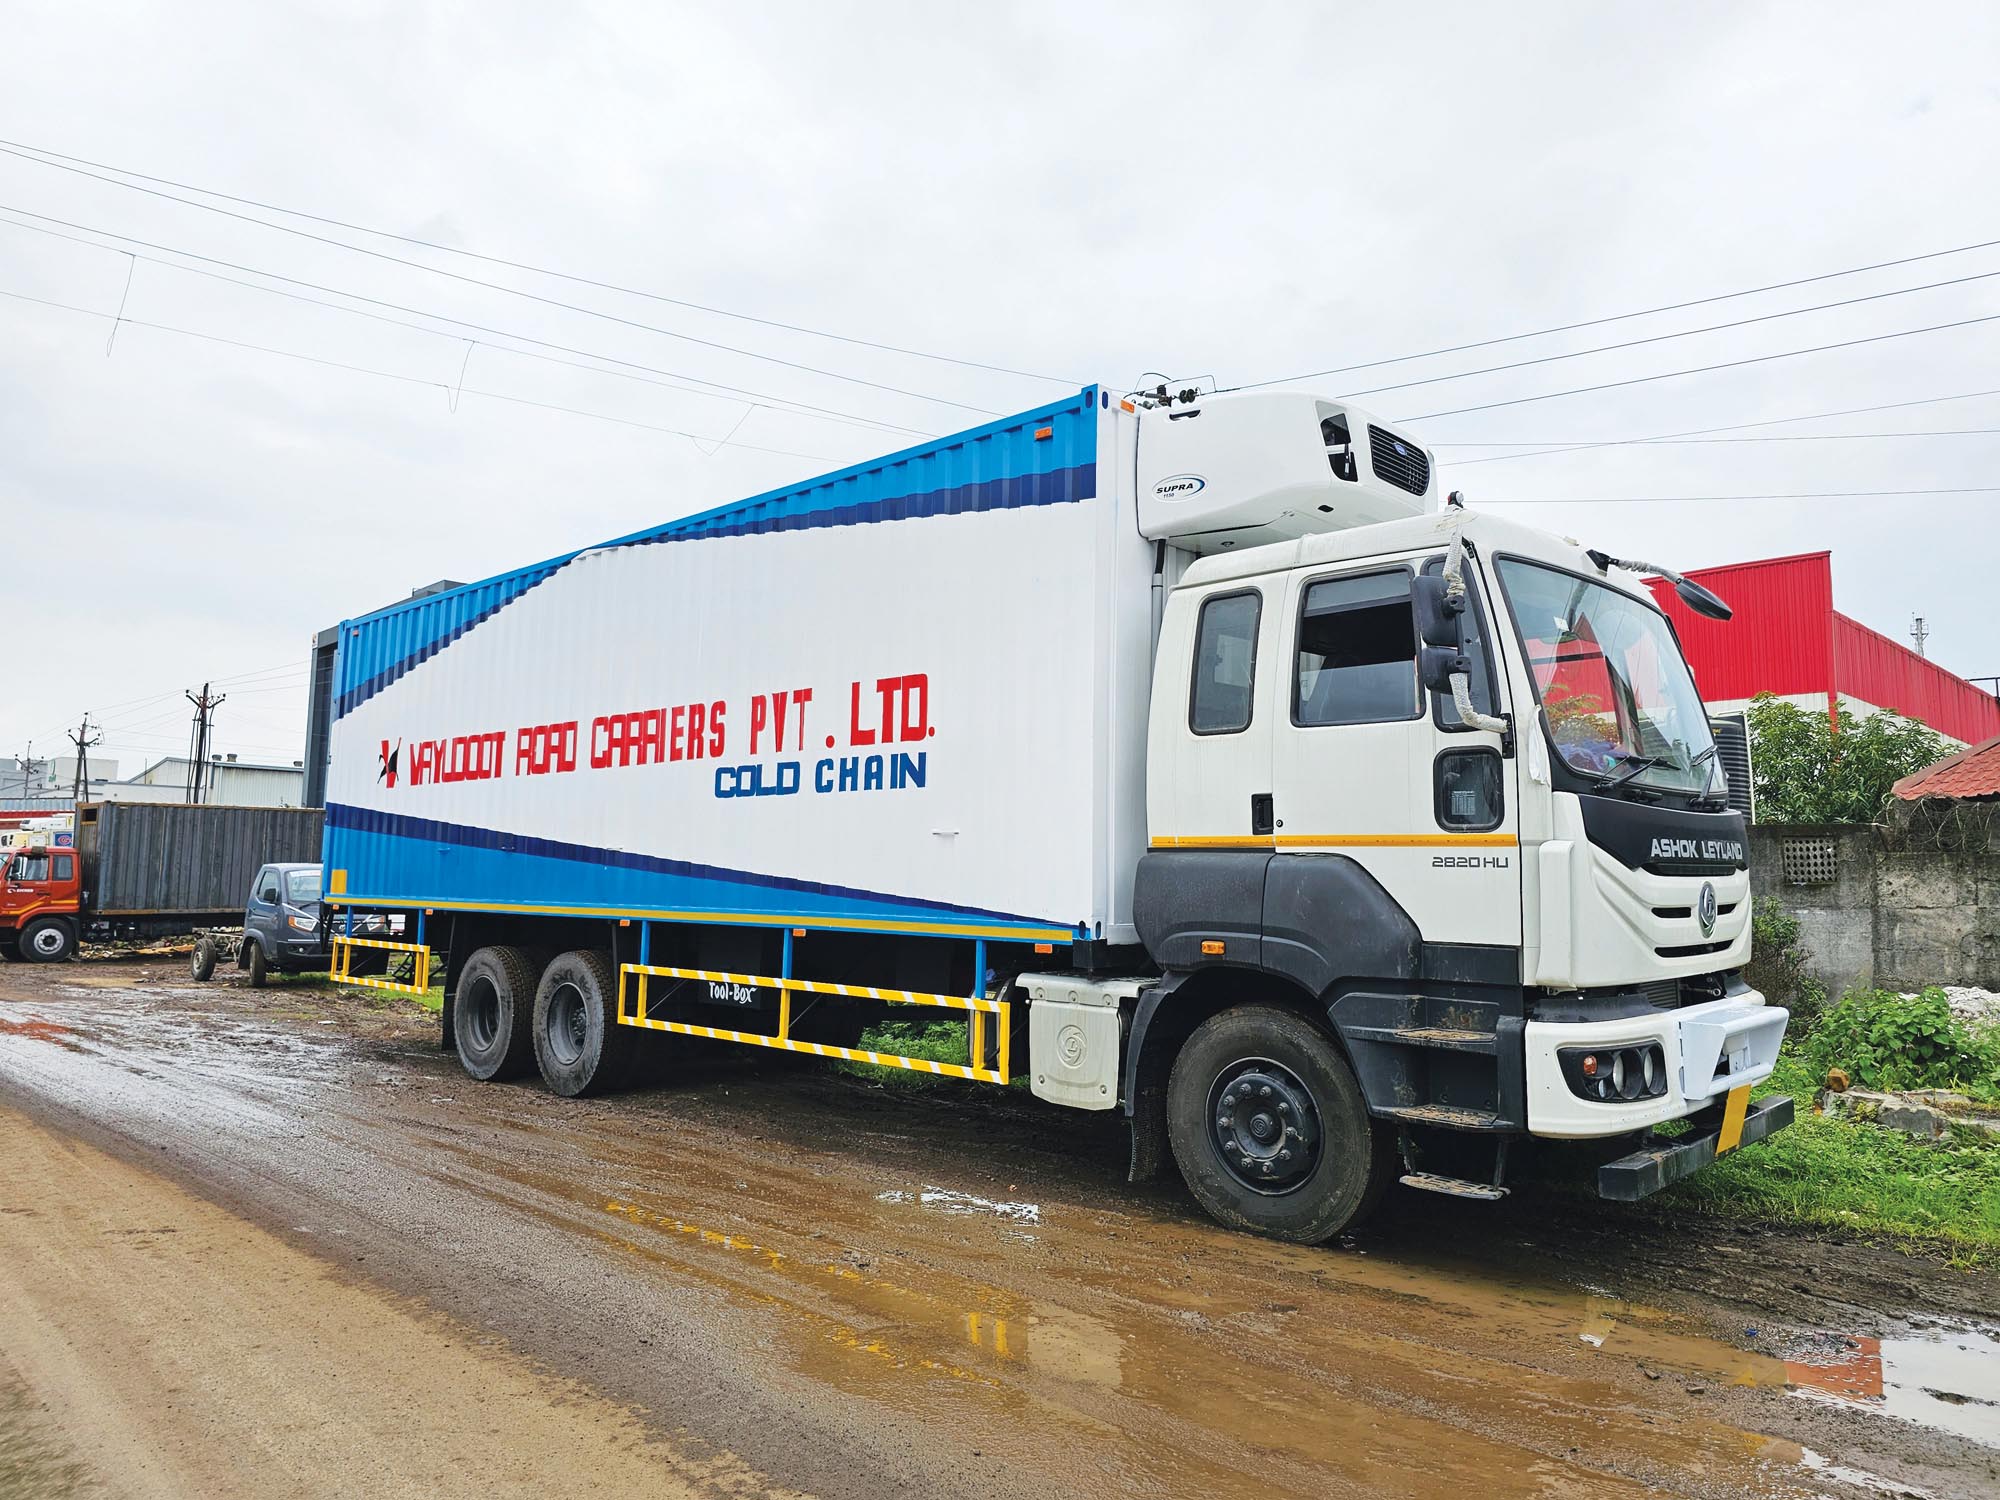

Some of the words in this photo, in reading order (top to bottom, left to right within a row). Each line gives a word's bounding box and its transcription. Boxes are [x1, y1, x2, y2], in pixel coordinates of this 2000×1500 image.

[1156, 483, 1193, 493] SUPRA
[516, 721, 578, 776] ROAD
[591, 701, 726, 769] CARRIERS
[850, 674, 935, 746] LTD.
[715, 761, 800, 798] COLD
[815, 752, 927, 793] CHAIN
[1651, 838, 1699, 858] ASHOK
[1701, 840, 1743, 860] LEYLAND
[1432, 856, 1481, 868] 2820
[1483, 857, 1508, 868] HU
